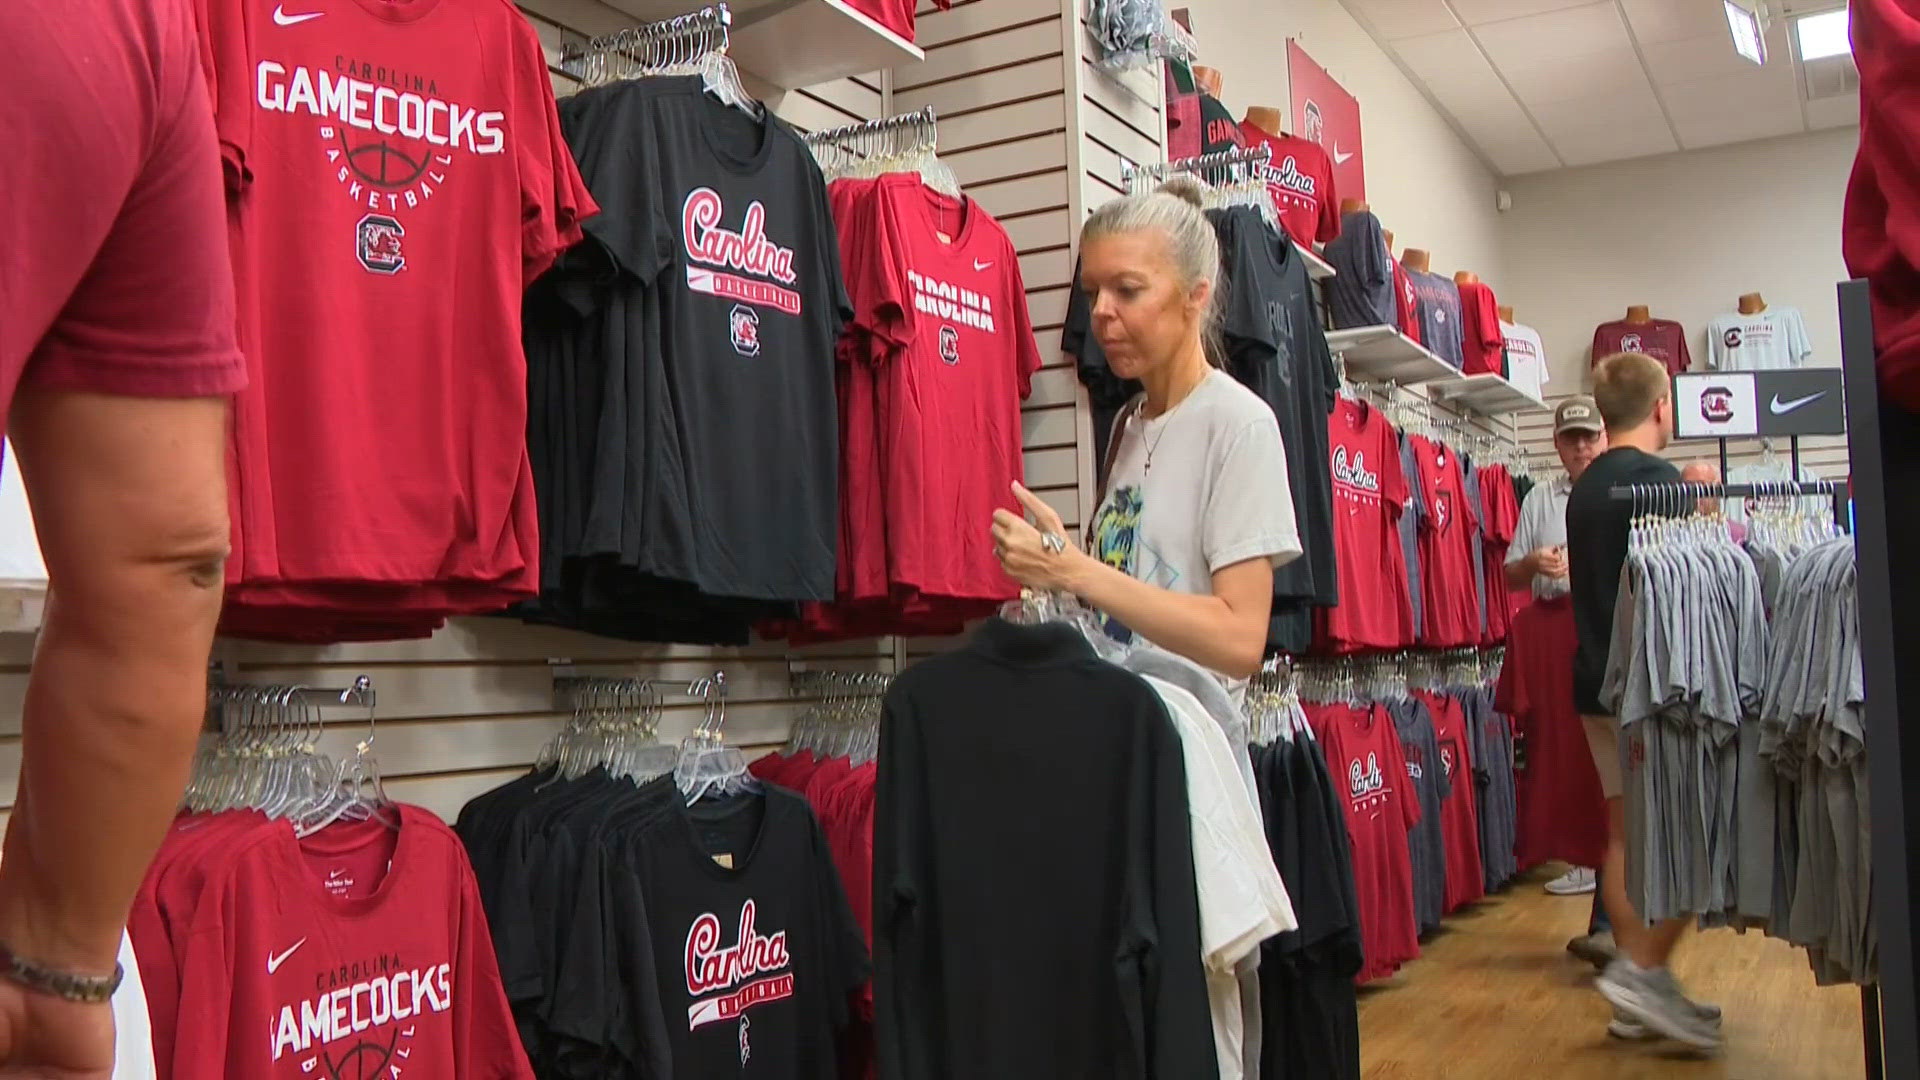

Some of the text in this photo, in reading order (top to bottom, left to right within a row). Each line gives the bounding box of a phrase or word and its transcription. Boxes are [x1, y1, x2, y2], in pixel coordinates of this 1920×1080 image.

[257, 60, 504, 154] GAMECOCKS
[336, 54, 438, 94] CAROLINA
[320, 125, 452, 212] BASKETBALL
[682, 186, 797, 284] Carolina
[317, 952, 402, 991] CAROLINA
